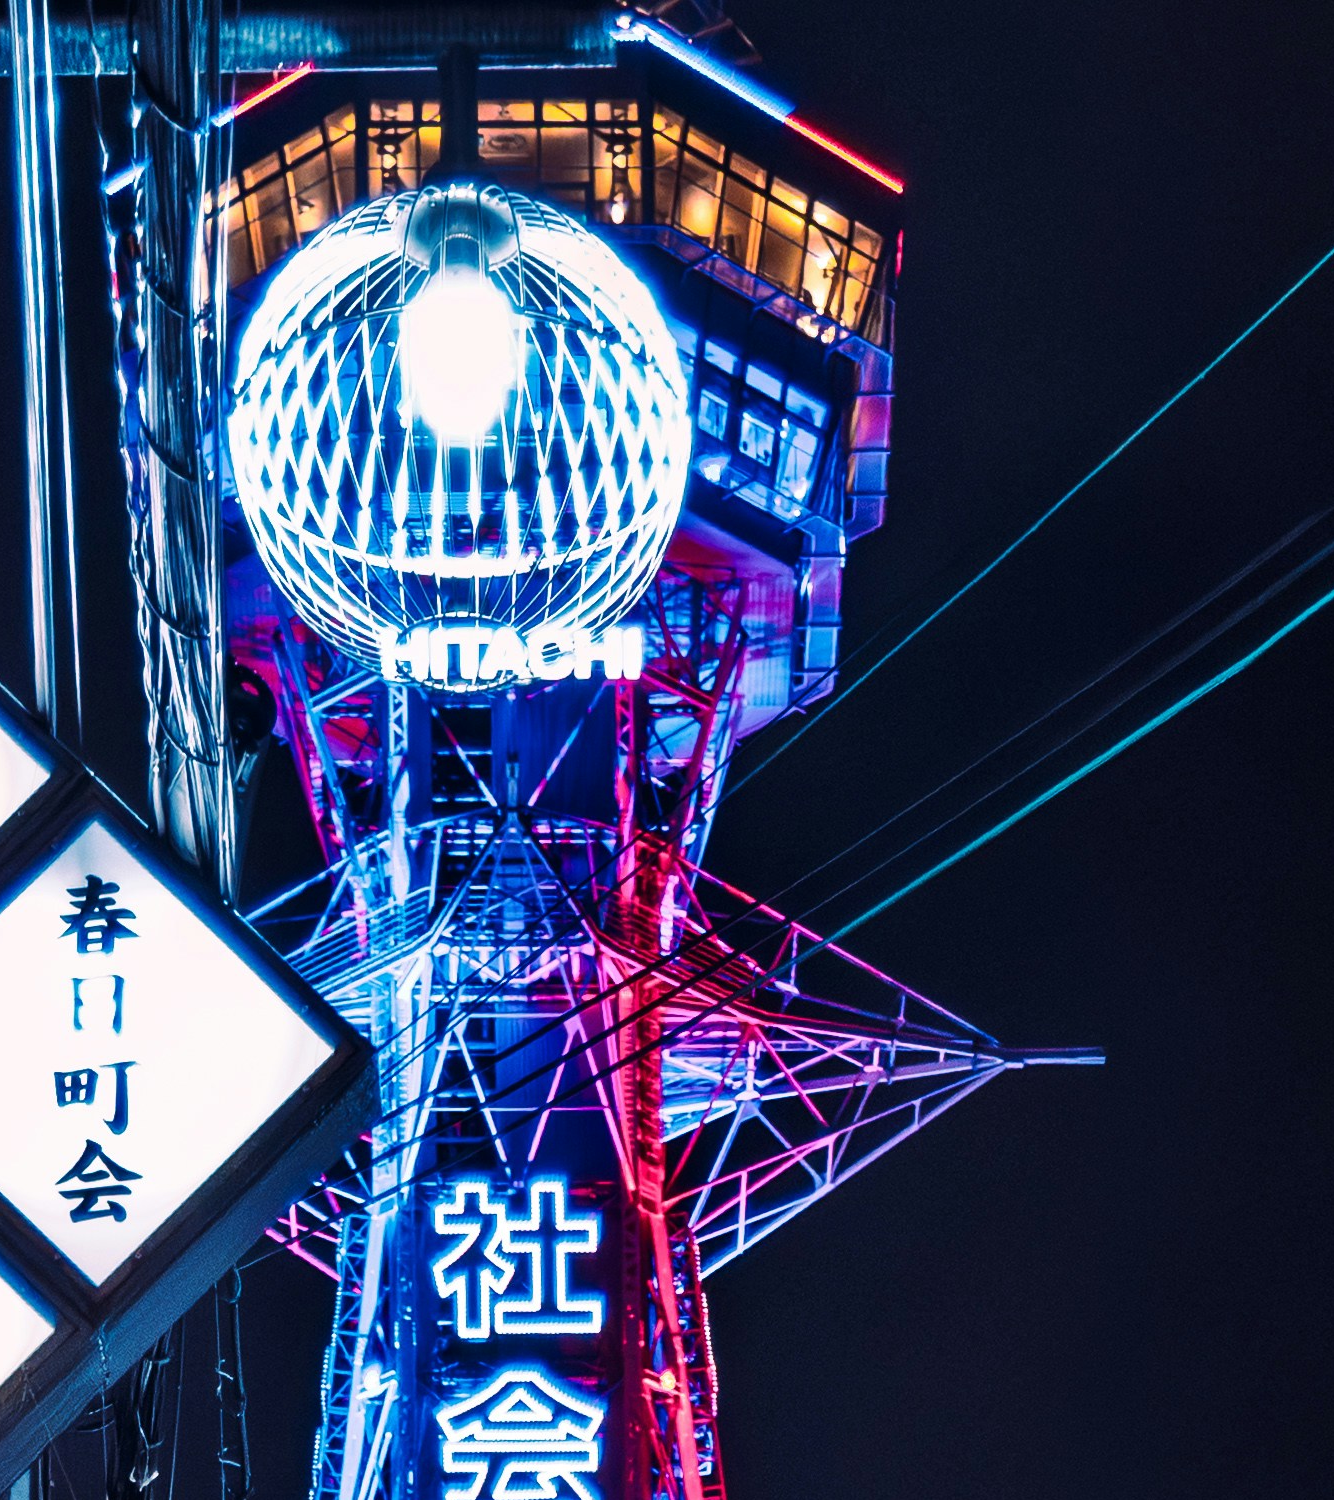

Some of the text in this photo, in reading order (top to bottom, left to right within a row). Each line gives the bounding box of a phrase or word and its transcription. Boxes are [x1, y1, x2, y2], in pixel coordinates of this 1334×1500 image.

[379, 625, 645, 682] HITACHI
[53, 874, 144, 1224] 春日町会
